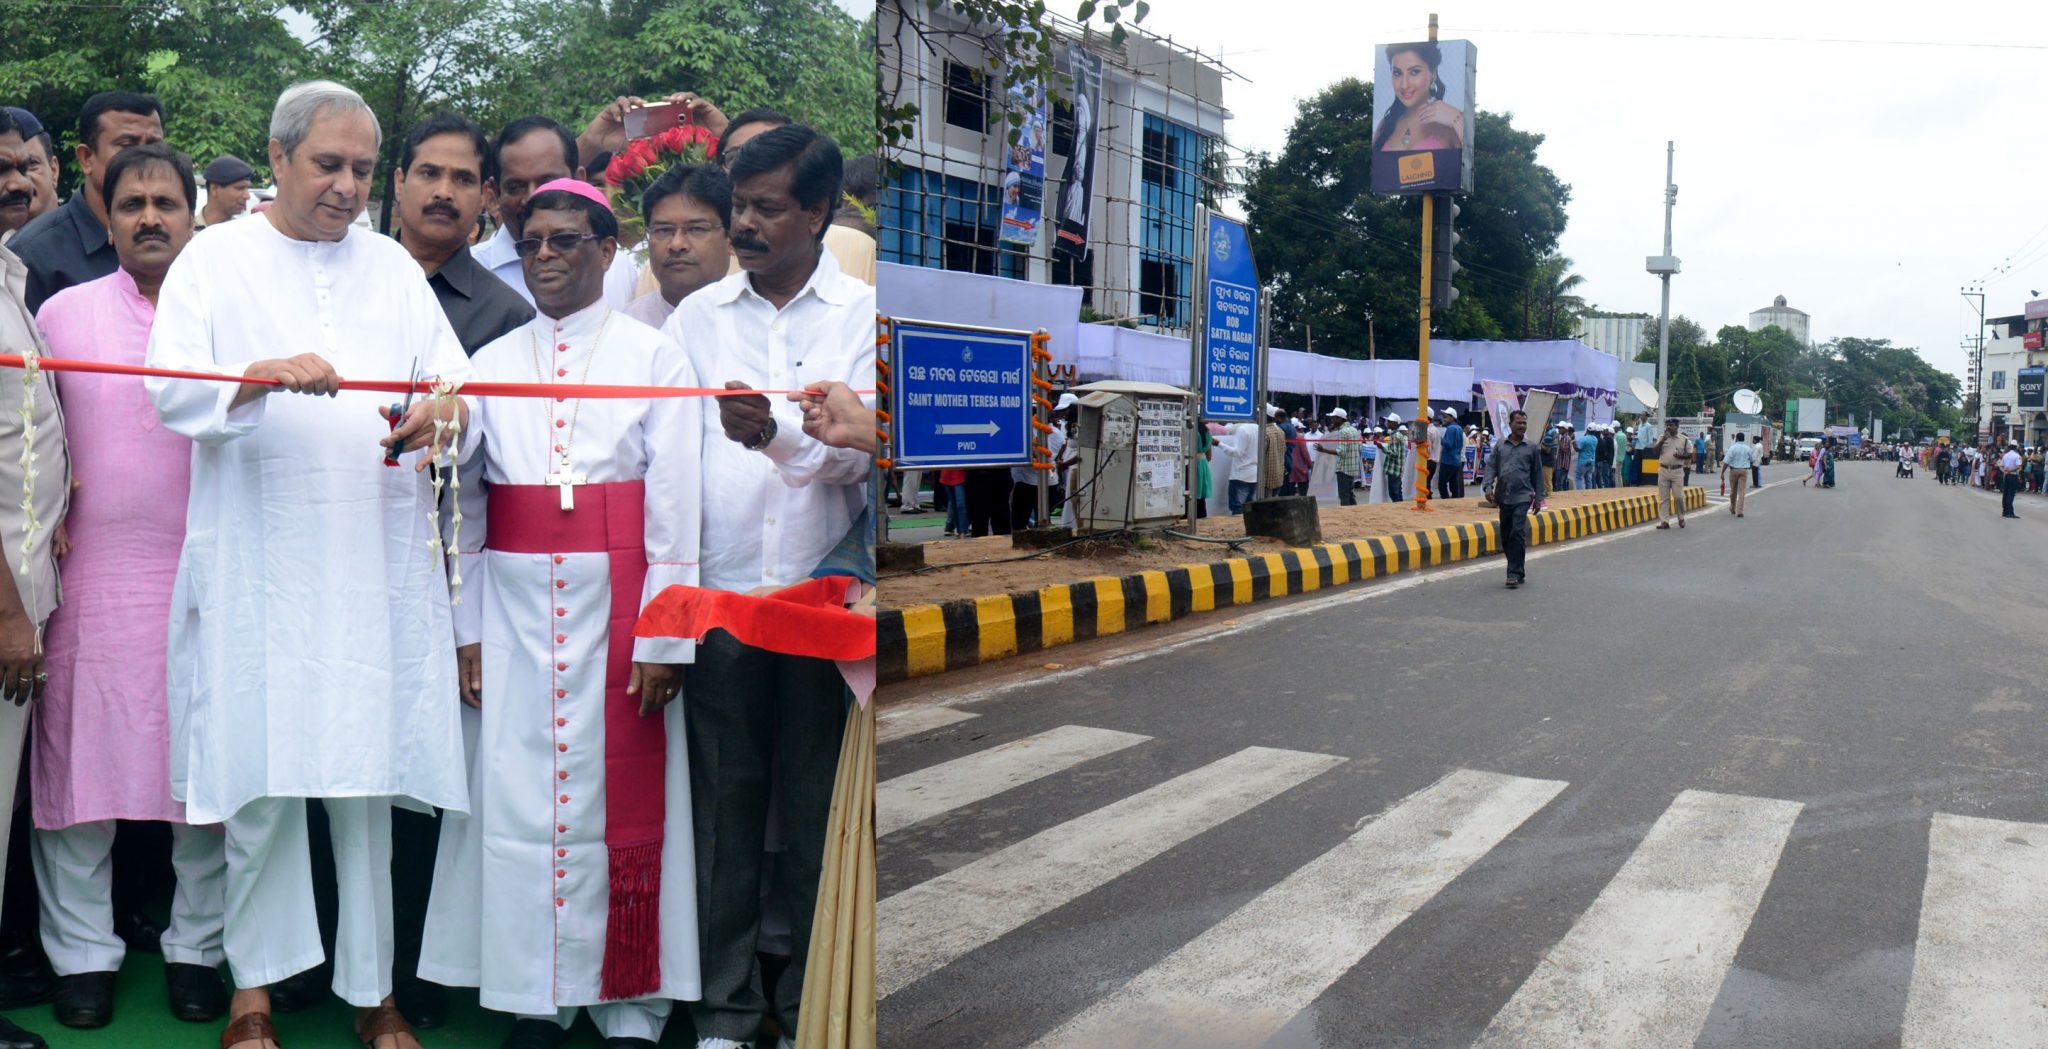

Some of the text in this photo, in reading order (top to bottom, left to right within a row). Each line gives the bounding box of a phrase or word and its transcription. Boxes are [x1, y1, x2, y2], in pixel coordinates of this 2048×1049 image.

[1226, 315, 1240, 329] ROB
[1211, 327, 1252, 345] SATYA NAGAR
[2019, 383, 2042, 391] SONY
[908, 392, 1021, 408] SAINT MOTHER TERESA ROAD
[957, 441, 977, 451] PWD
